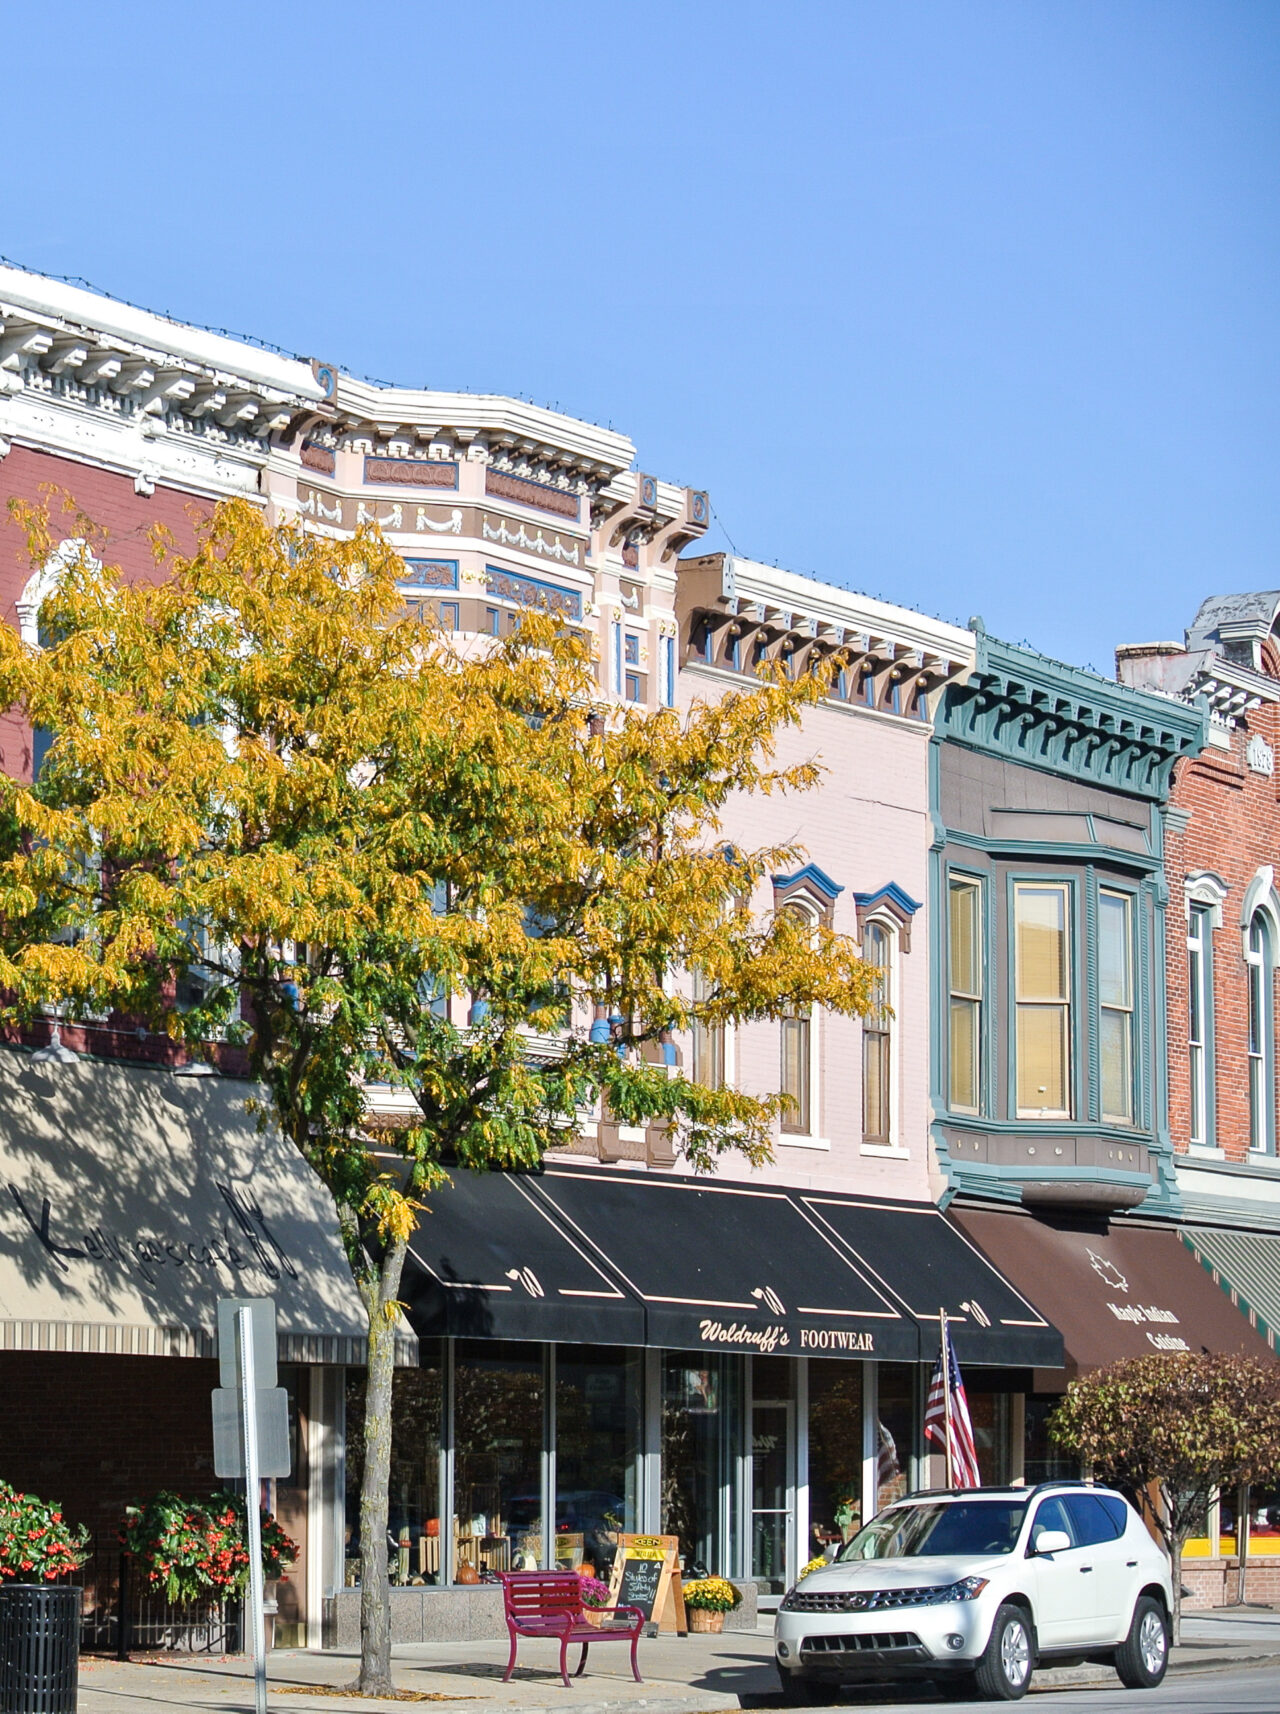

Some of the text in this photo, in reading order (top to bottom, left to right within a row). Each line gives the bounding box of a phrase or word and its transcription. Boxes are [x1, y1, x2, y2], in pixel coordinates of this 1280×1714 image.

[1106, 1302, 1179, 1325] Maple Indian
[699, 1319, 874, 1352] Woldruff's FOOTWEAR
[1146, 1332, 1190, 1350] Cuisine
[634, 1537, 660, 1546] KEEN
[638, 1562, 648, 1572] 10
[625, 1571, 658, 1584] Styles of
